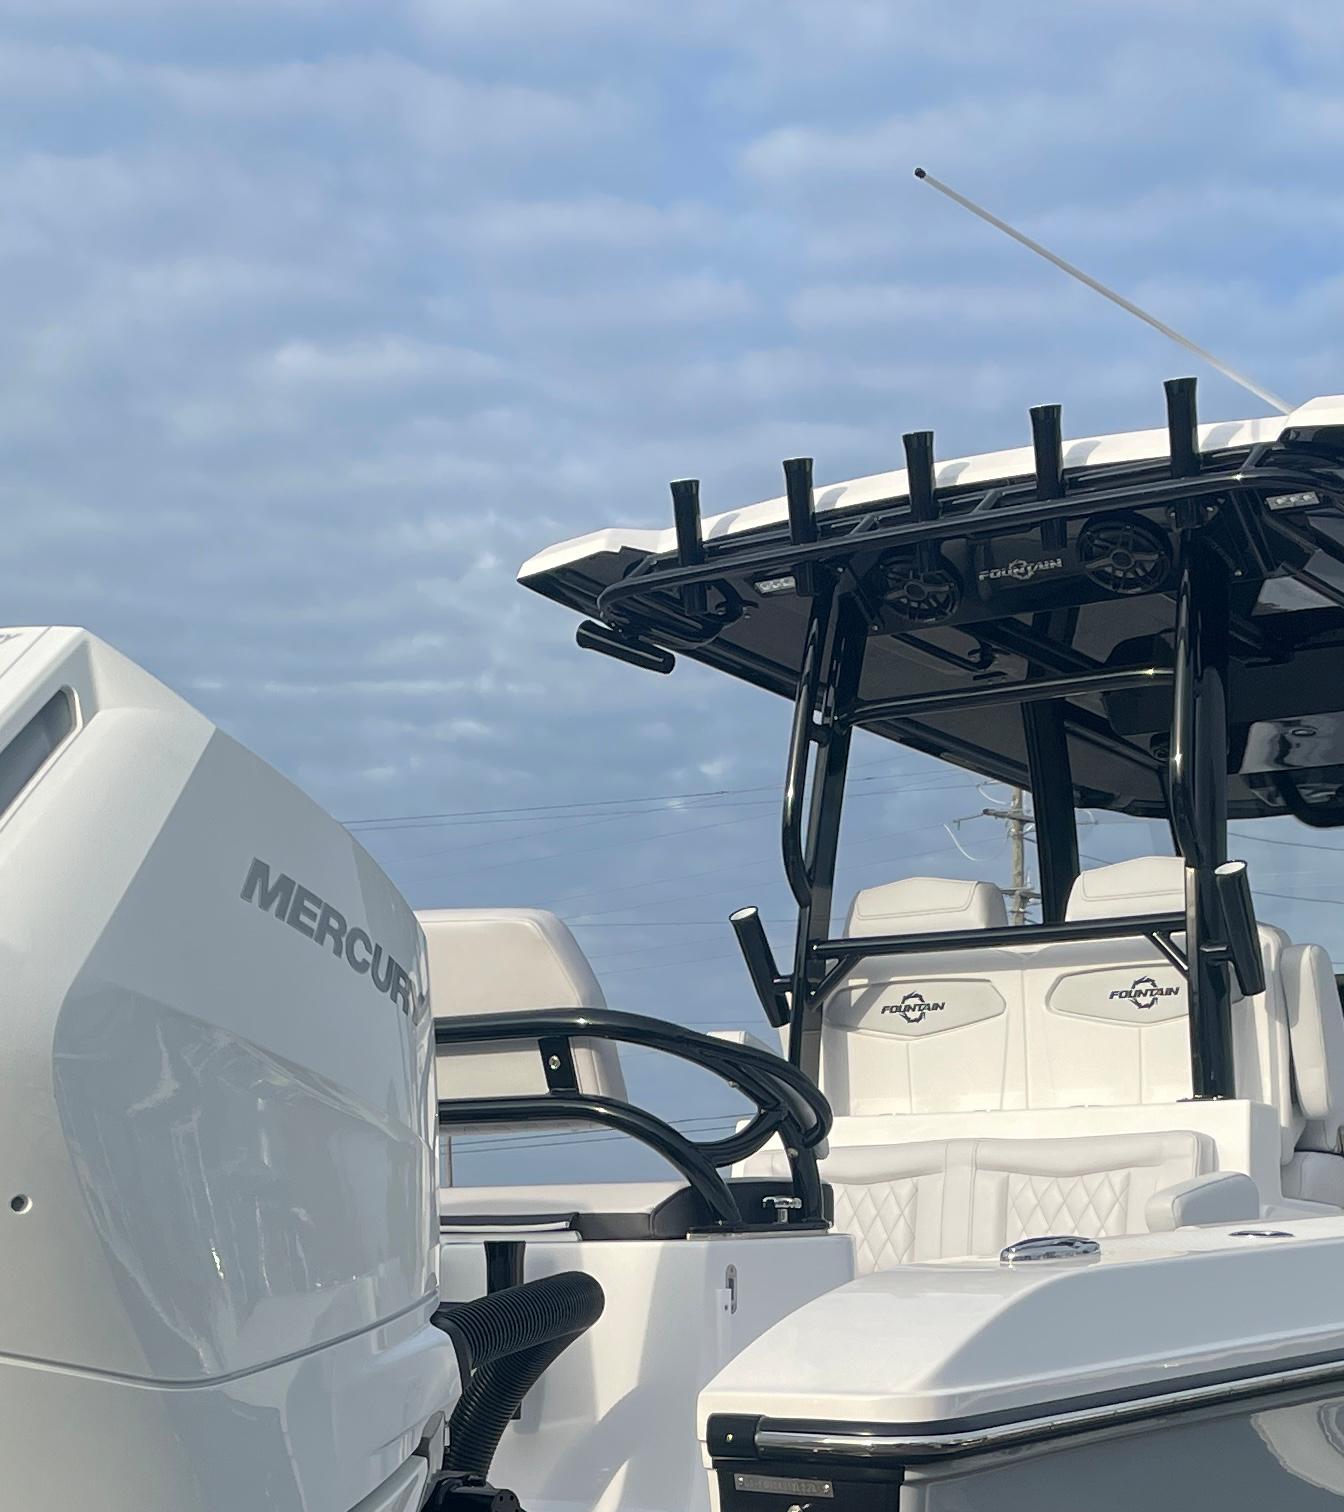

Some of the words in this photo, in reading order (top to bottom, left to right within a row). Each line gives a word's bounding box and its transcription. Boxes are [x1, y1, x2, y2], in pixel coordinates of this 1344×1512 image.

[978, 558, 1063, 581] FOUNTAIN
[1109, 986, 1180, 1000] FOUNTAIN
[881, 1001, 946, 1014] FOUNTAIN
